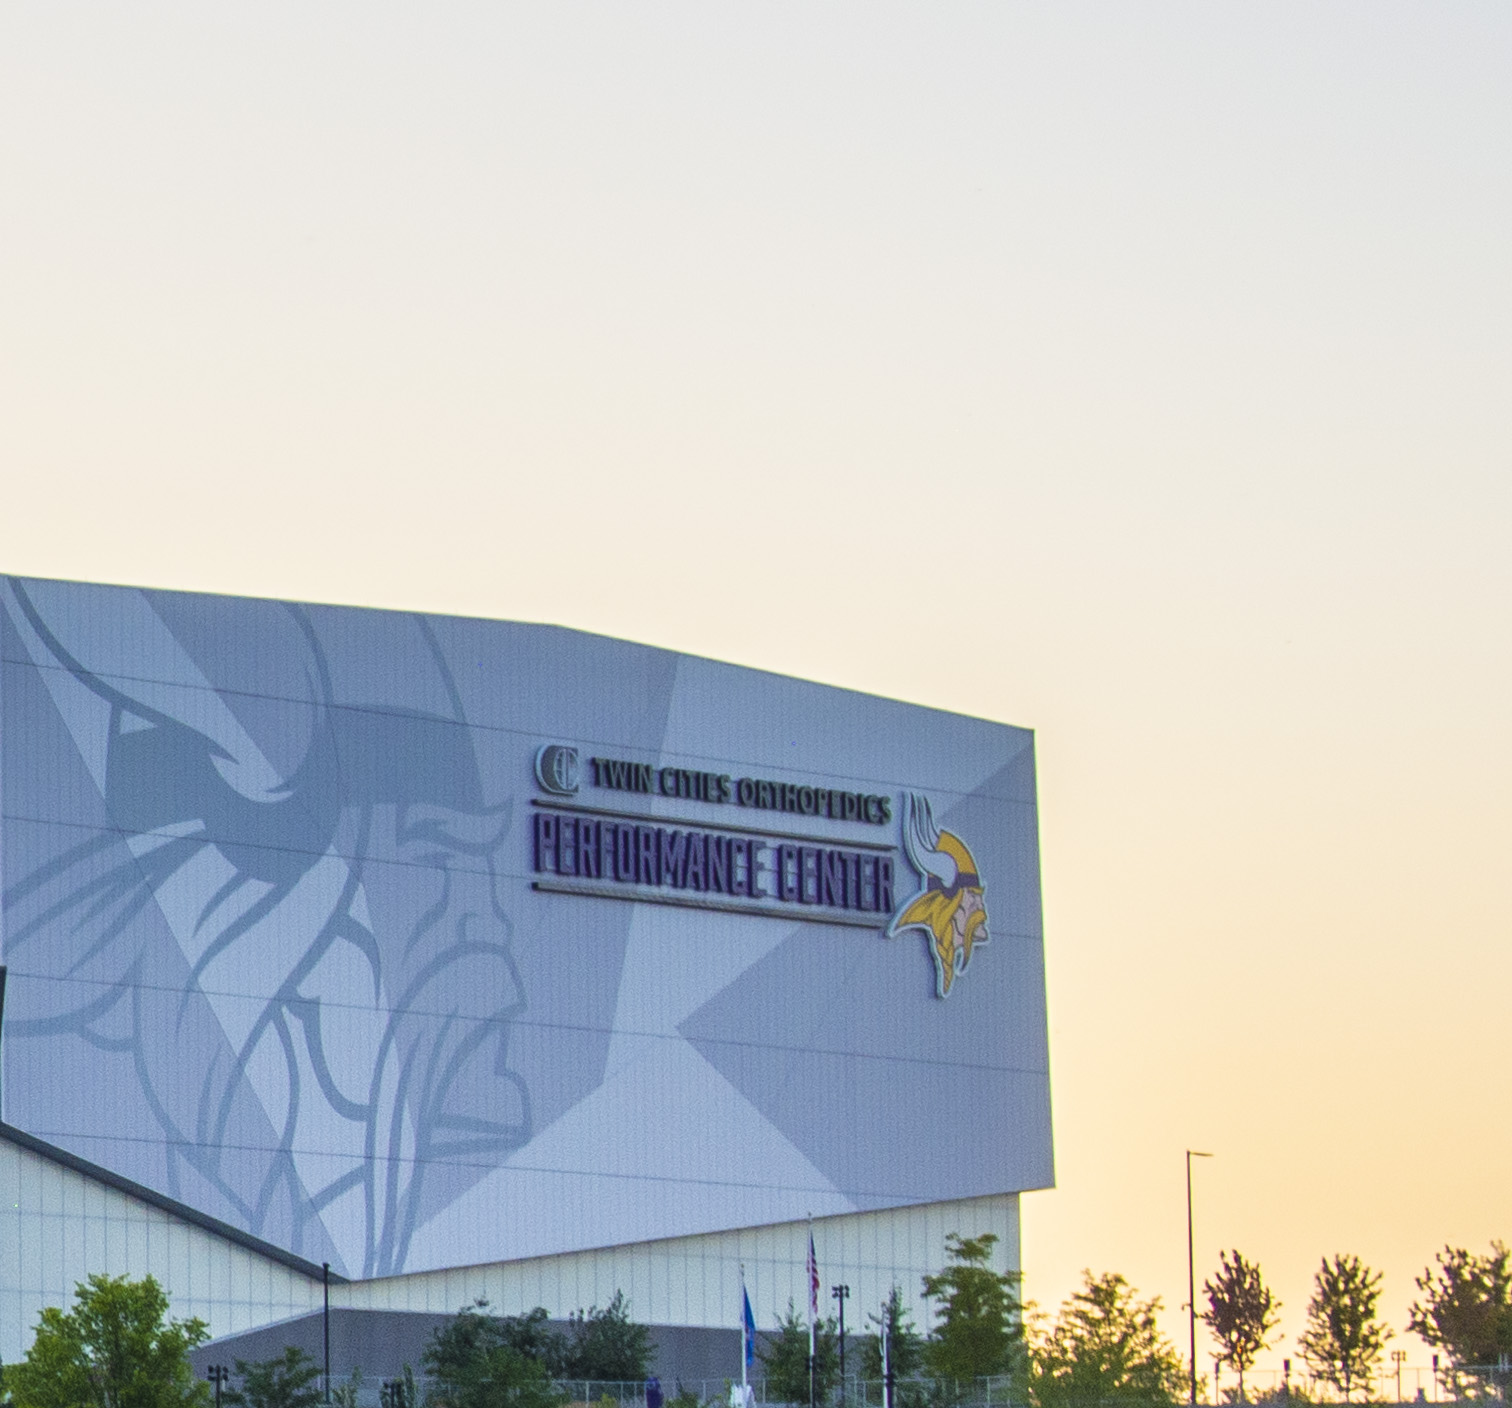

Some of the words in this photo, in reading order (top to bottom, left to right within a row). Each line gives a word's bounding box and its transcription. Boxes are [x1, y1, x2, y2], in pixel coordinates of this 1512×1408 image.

[591, 757, 653, 794] TWIN
[659, 767, 731, 803] CITIES
[737, 777, 892, 825] ORTHOPEDICS
[534, 812, 767, 898] PERFORMANCE
[777, 843, 895, 914] CENTER
